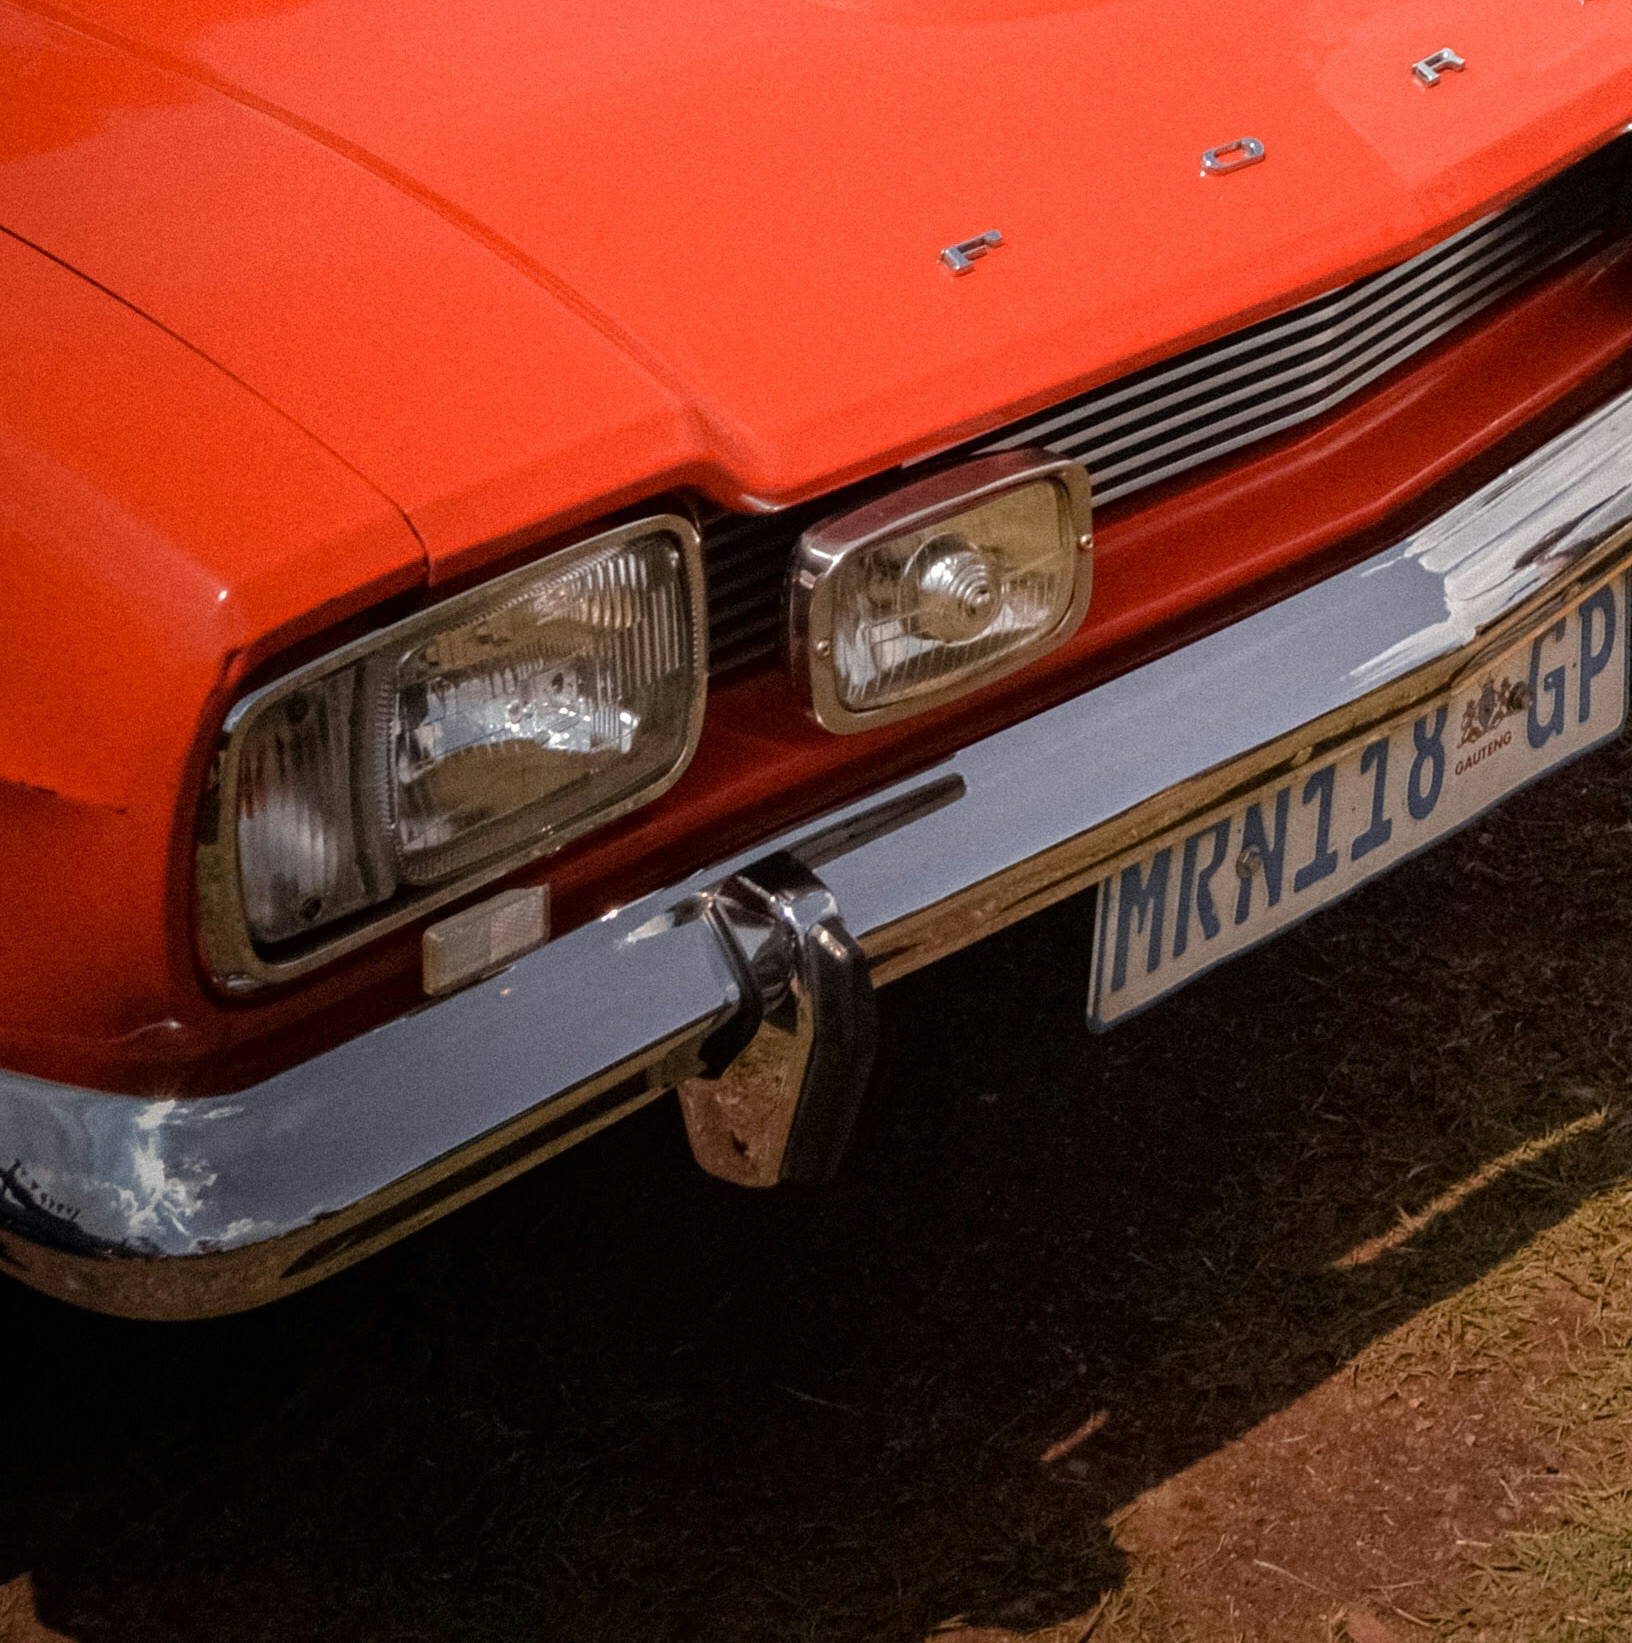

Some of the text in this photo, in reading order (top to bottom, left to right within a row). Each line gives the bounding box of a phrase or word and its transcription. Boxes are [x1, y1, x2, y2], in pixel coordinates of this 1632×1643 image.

[1110, 582, 1618, 993] MRN118 GP
[1455, 731, 1512, 776] GAUTENG
